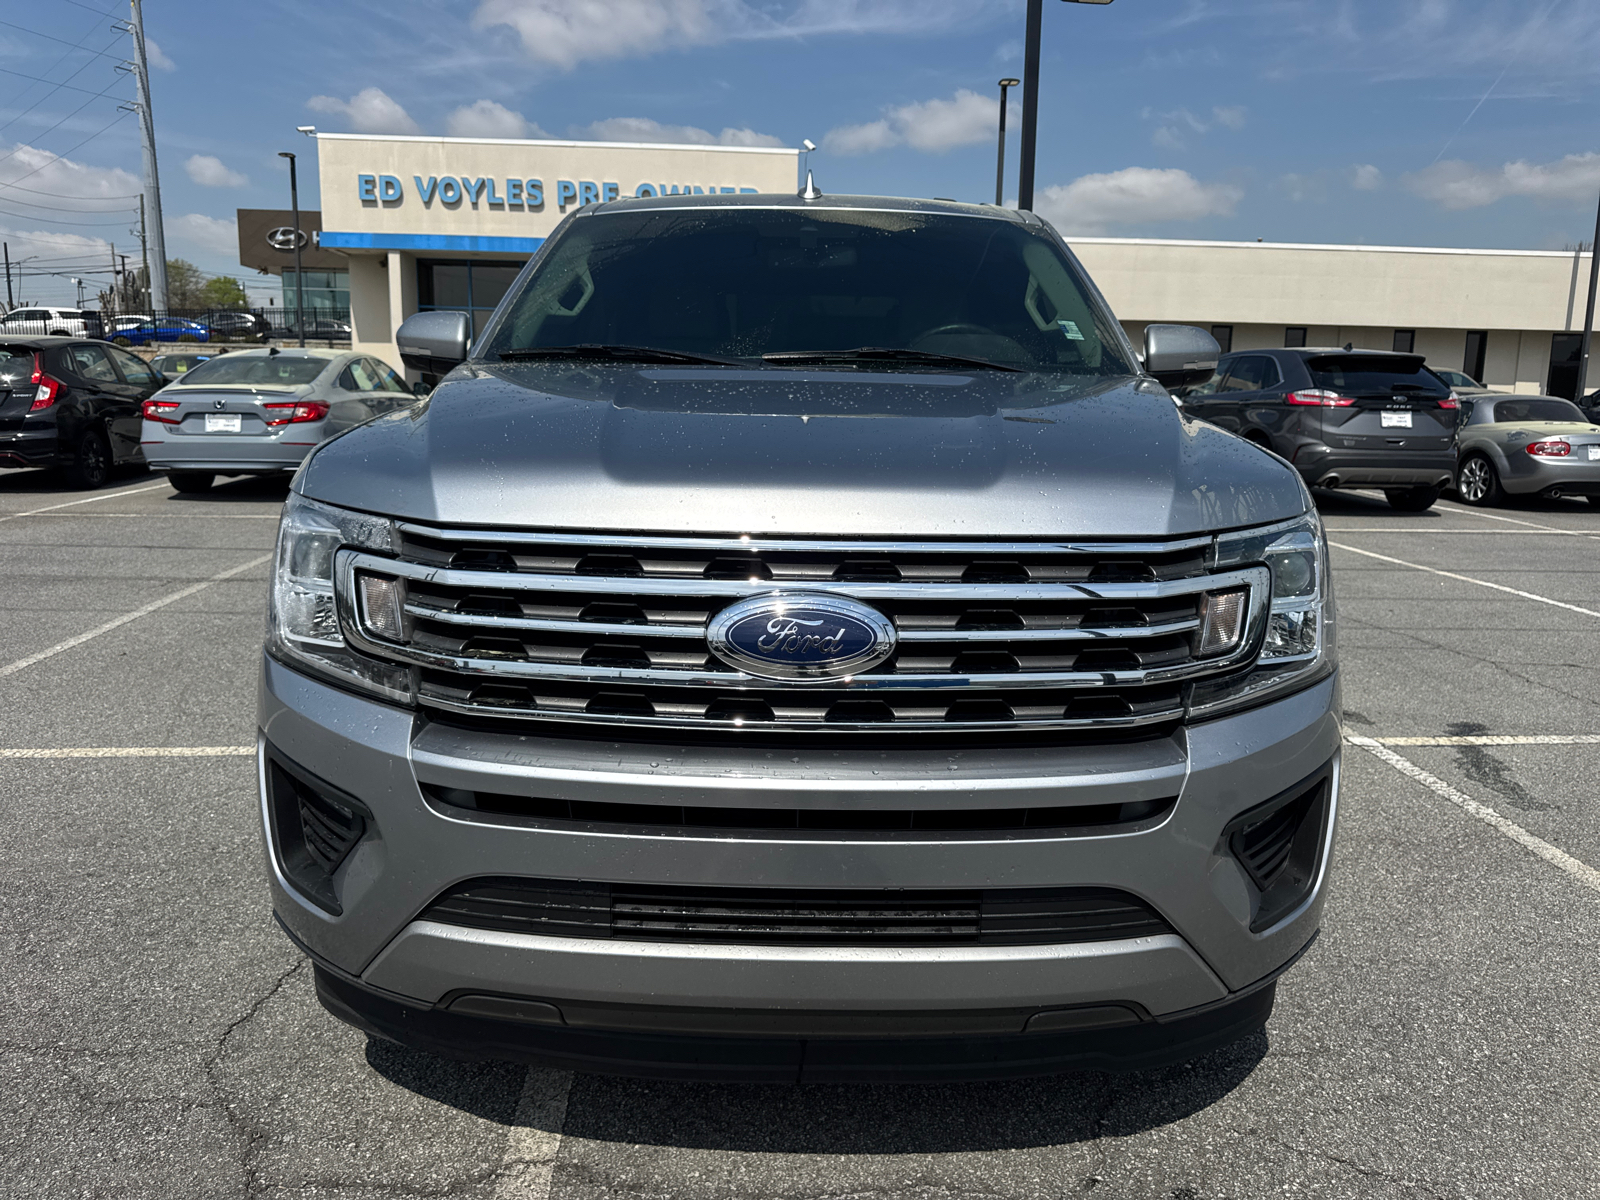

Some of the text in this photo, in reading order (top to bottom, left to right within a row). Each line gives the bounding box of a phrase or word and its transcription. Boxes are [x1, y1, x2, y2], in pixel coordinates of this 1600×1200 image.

[358, 174, 403, 201] ED
[413, 175, 544, 206] VOYLES
[757, 616, 846, 654] Ford
